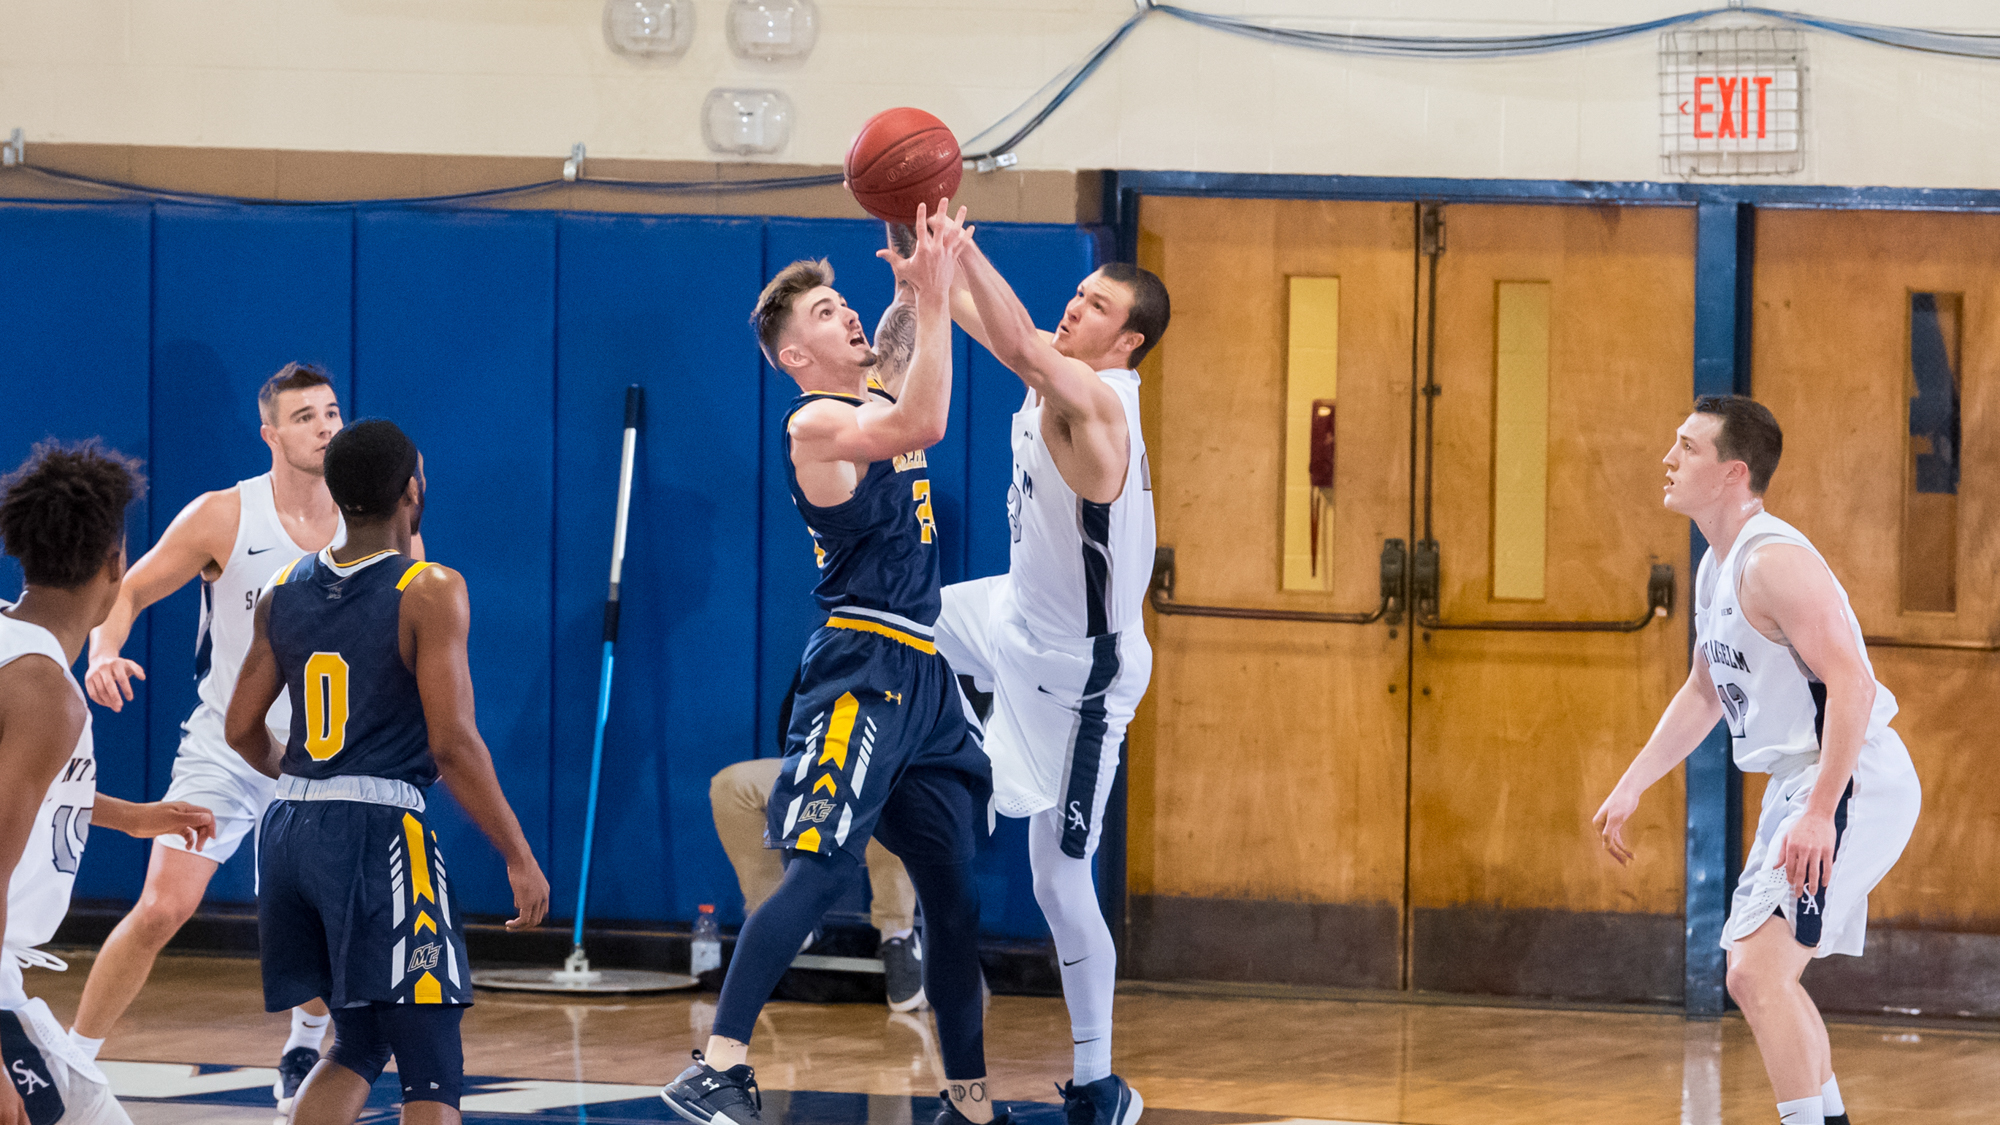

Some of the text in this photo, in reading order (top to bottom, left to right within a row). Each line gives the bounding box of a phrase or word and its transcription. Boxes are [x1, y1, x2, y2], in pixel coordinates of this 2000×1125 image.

[1694, 77, 1773, 139] EXIT
[304, 652, 349, 761] 0
[1068, 800, 1088, 831] SA
[1801, 882, 1820, 915] SA
[12, 1059, 50, 1095] SA
